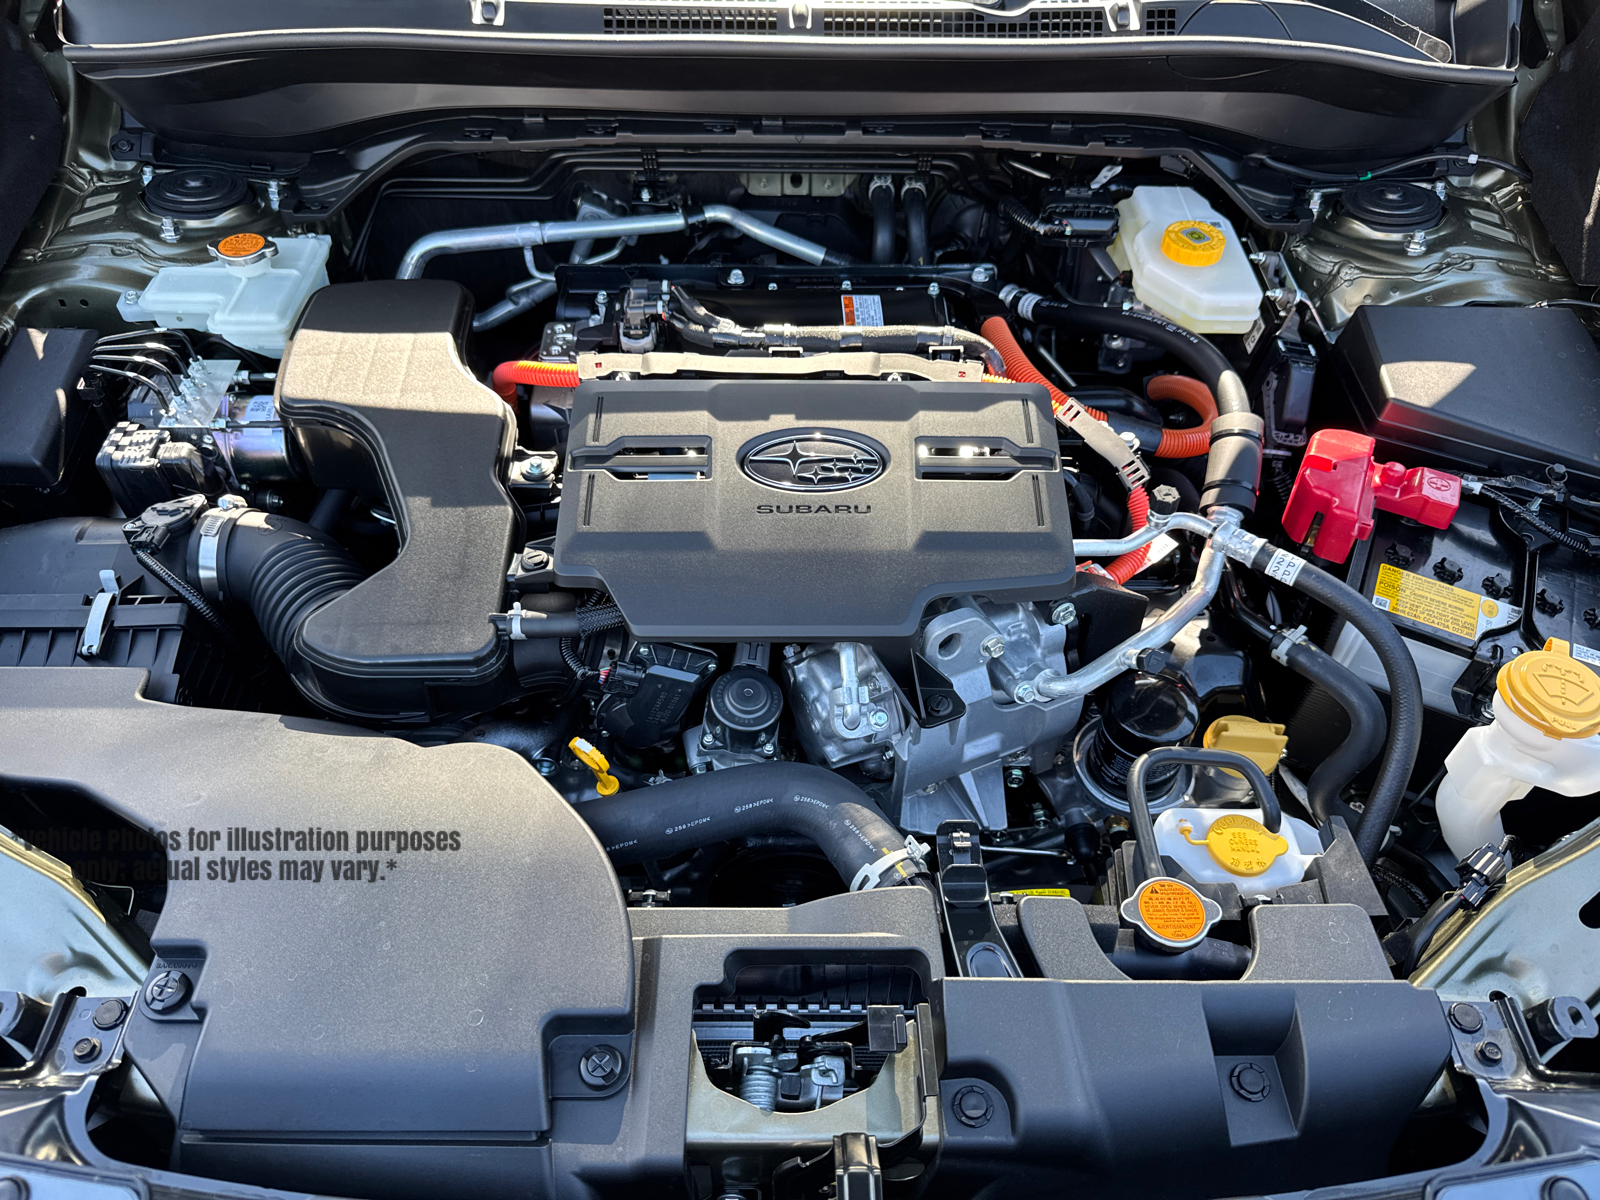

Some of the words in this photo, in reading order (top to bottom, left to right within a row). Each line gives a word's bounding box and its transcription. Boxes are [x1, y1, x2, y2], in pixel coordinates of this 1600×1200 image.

[757, 504, 871, 514] SUBARU
[1383, 565, 1410, 577] DANGER
[1379, 581, 1406, 593] POISON
[1551, 716, 1577, 730] PULL
[1214, 816, 1267, 836] COOLANT
